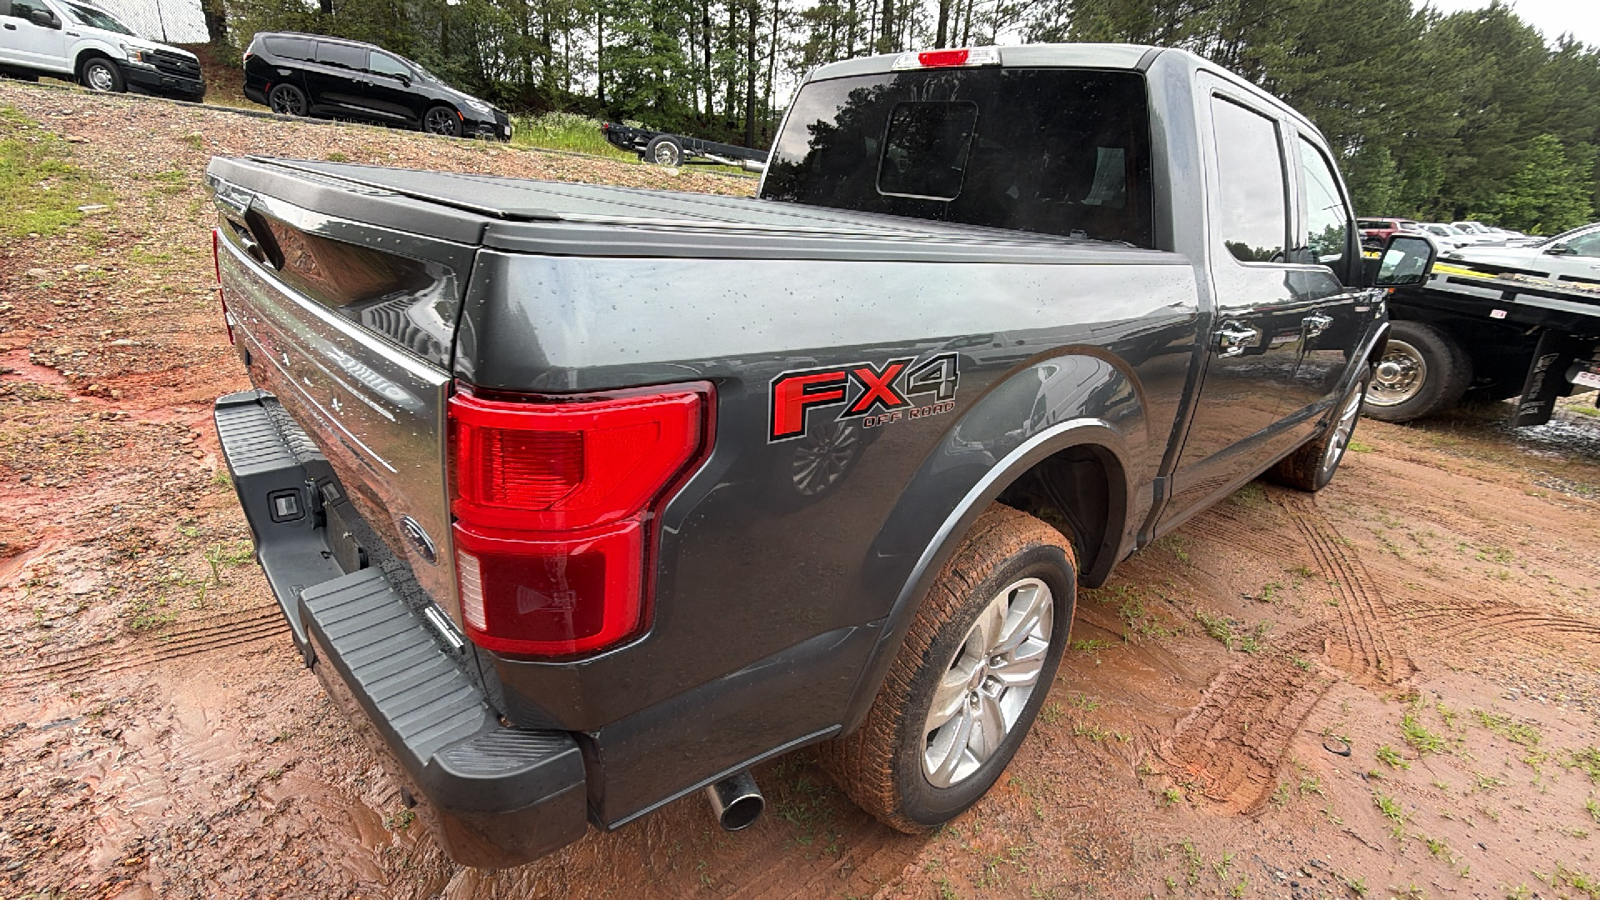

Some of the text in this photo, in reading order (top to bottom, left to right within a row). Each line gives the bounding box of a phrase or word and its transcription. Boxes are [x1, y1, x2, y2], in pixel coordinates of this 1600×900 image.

[767, 352, 960, 444] FX4
[863, 401, 955, 428] OFF ROAD
